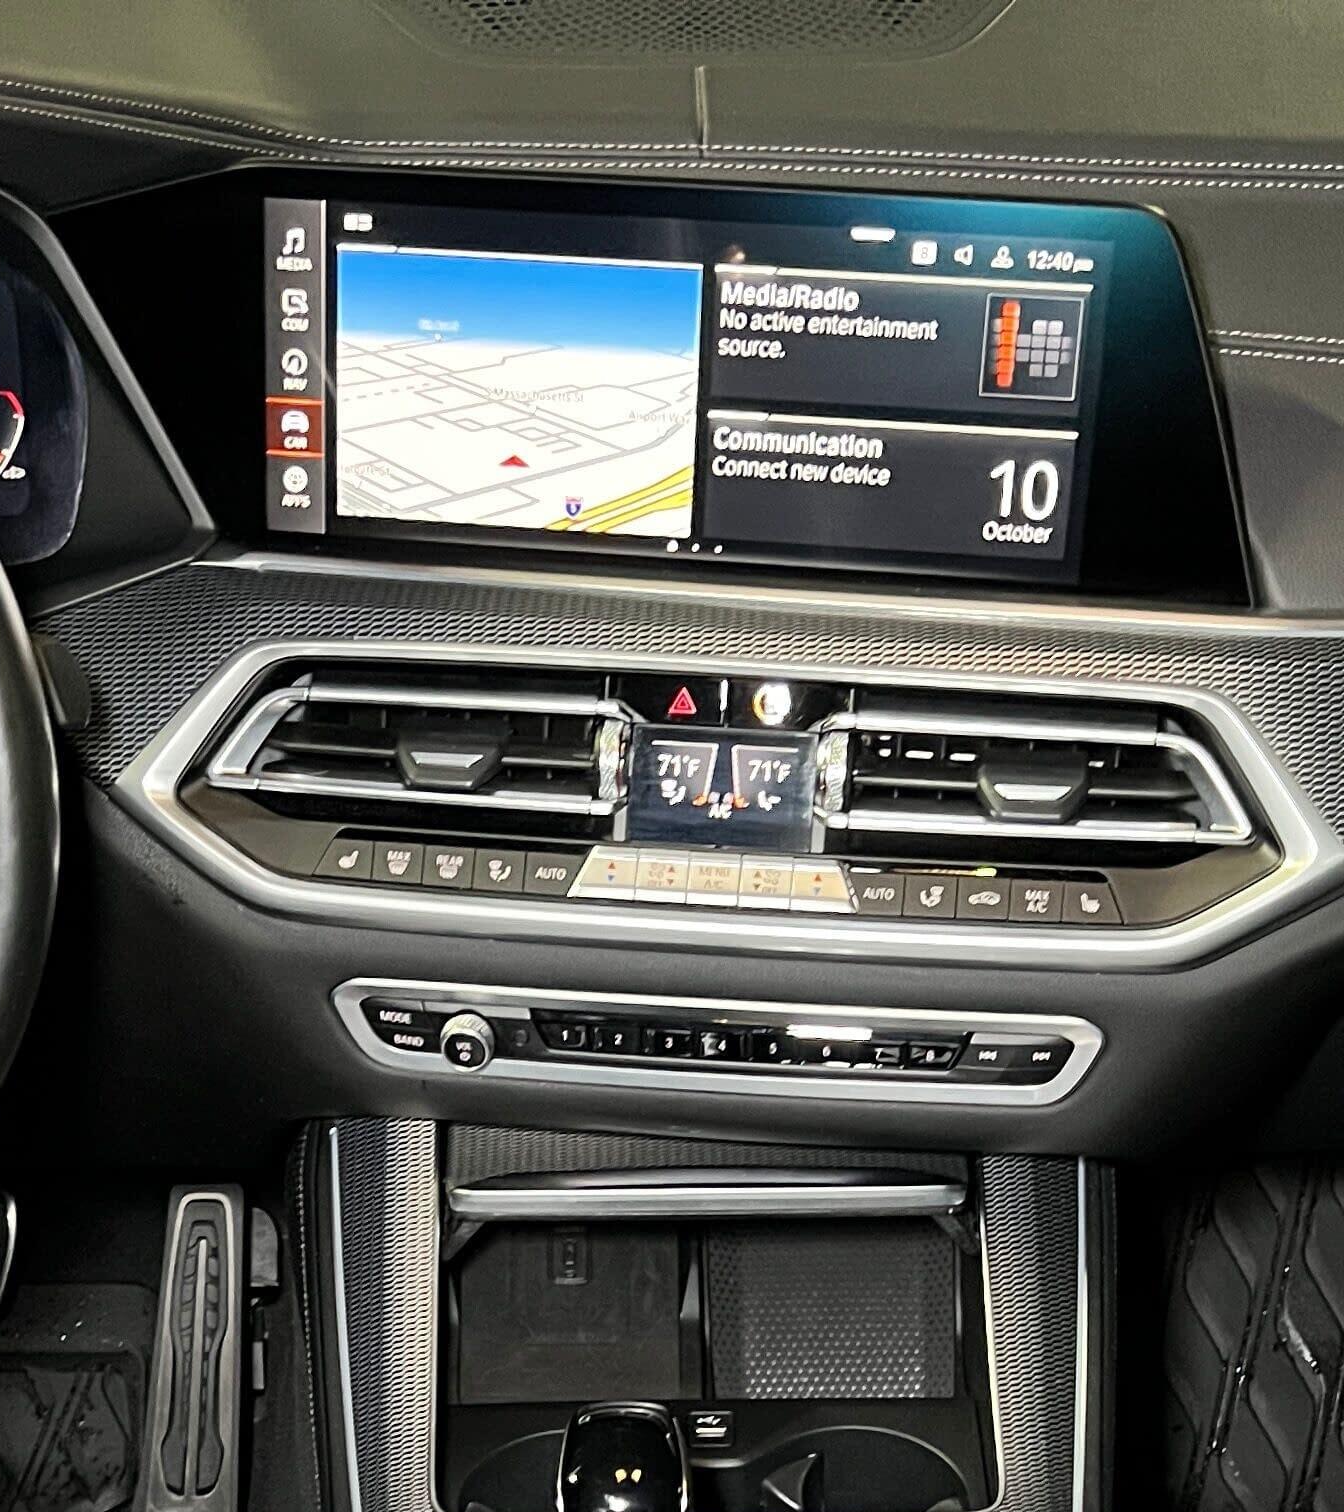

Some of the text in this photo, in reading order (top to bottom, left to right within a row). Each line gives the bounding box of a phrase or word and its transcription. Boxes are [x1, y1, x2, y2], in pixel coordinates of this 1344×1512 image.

[720, 281, 860, 311] Media/Radio
[719, 309, 939, 342] No active entertainment
[717, 338, 786, 360] source.
[713, 426, 884, 460] Communication
[711, 455, 892, 488] Connect new device
[989, 458, 1059, 523] 10
[982, 521, 1053, 545] October
[534, 865, 568, 882] AUTO
[863, 886, 895, 901] AUTO
[613, 1033, 624, 1047] 2
[664, 1036, 675, 1050] 3
